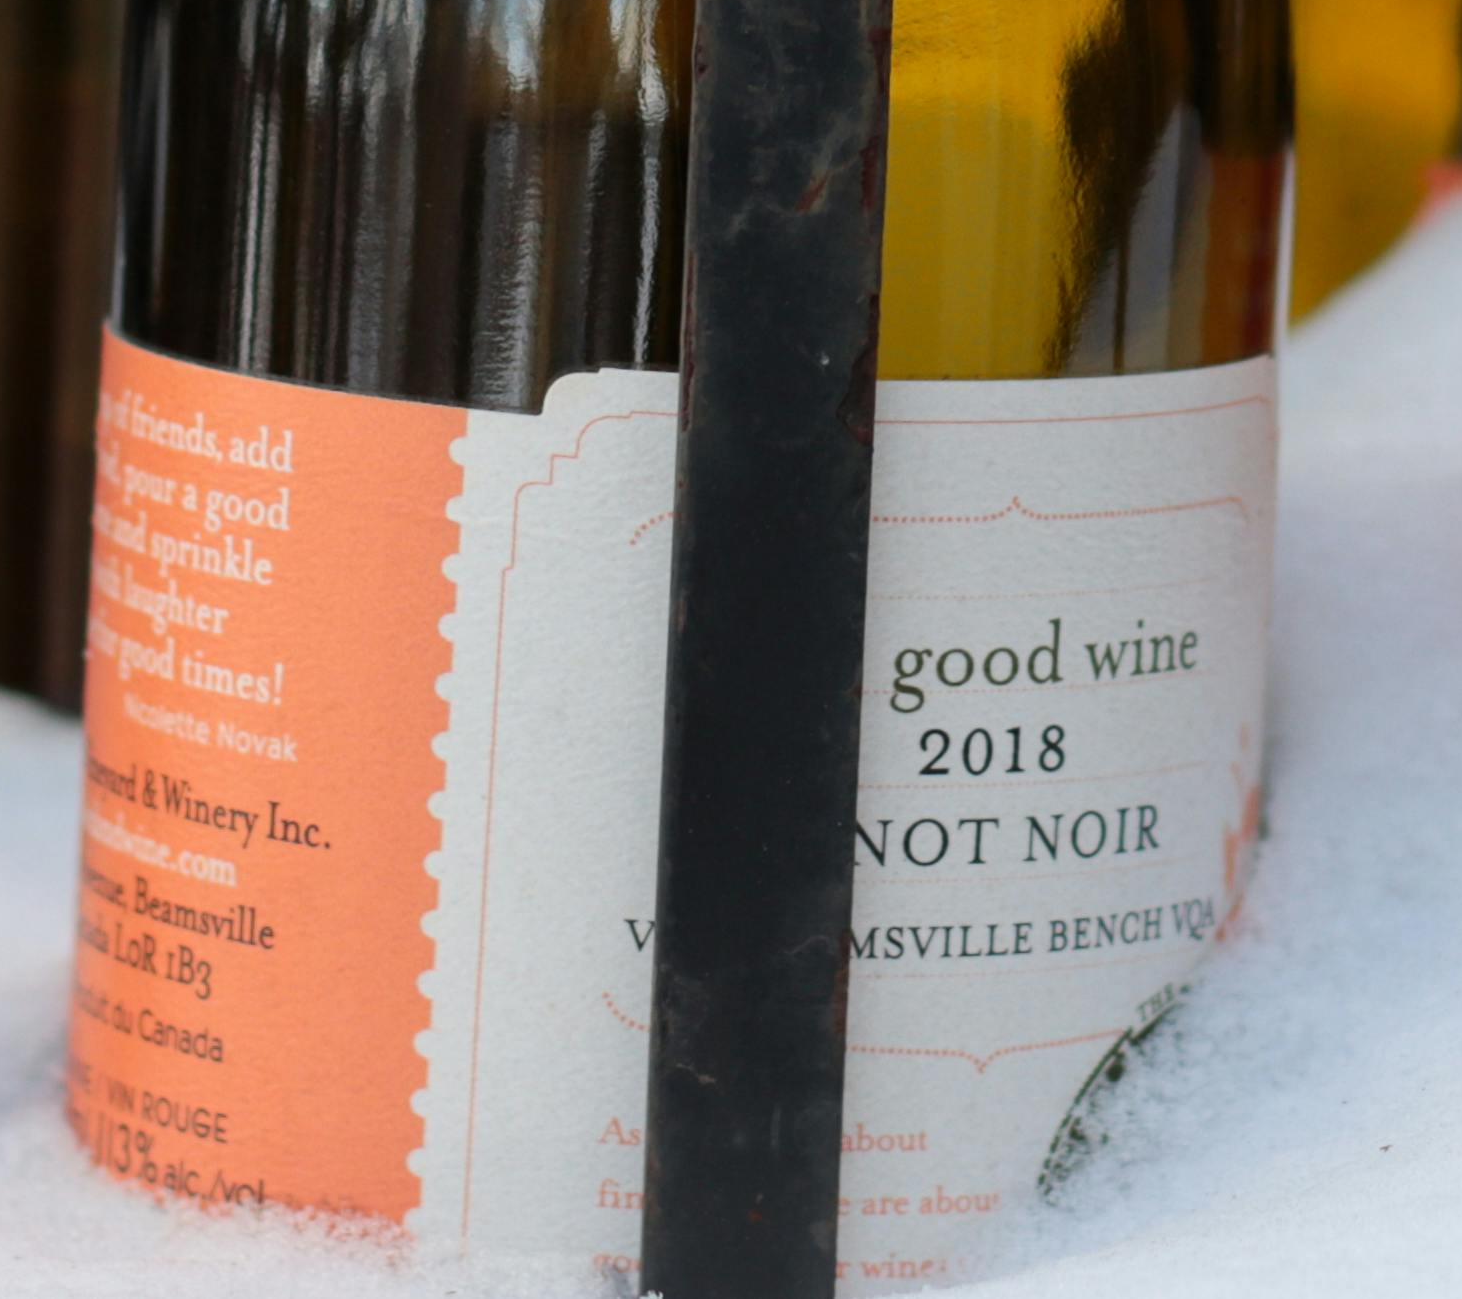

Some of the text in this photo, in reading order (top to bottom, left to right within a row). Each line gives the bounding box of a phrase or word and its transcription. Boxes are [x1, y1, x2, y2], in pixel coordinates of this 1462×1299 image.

[131, 391, 224, 463] friends,
[228, 424, 294, 474] add
[181, 482, 199, 513] a
[203, 486, 291, 532] good
[149, 531, 274, 586] sprinkle
[123, 563, 230, 635] laughter
[117, 636, 285, 706] good times!
[889, 618, 1198, 714] good wine
[216, 719, 299, 762] Novak
[918, 724, 1067, 776] 2018
[142, 768, 159, 810] &
[161, 773, 259, 850] Winery
[266, 800, 331, 850] Inc.
[1022, 803, 1160, 863] NOIR
[134, 875, 275, 950] Beamsville
[1047, 905, 1163, 954] BENCH
[1171, 896, 1216, 942] VQA
[138, 1006, 224, 1063] Canada
[141, 1090, 229, 1145] ROUGE
[860, 1195, 911, 1217] are
